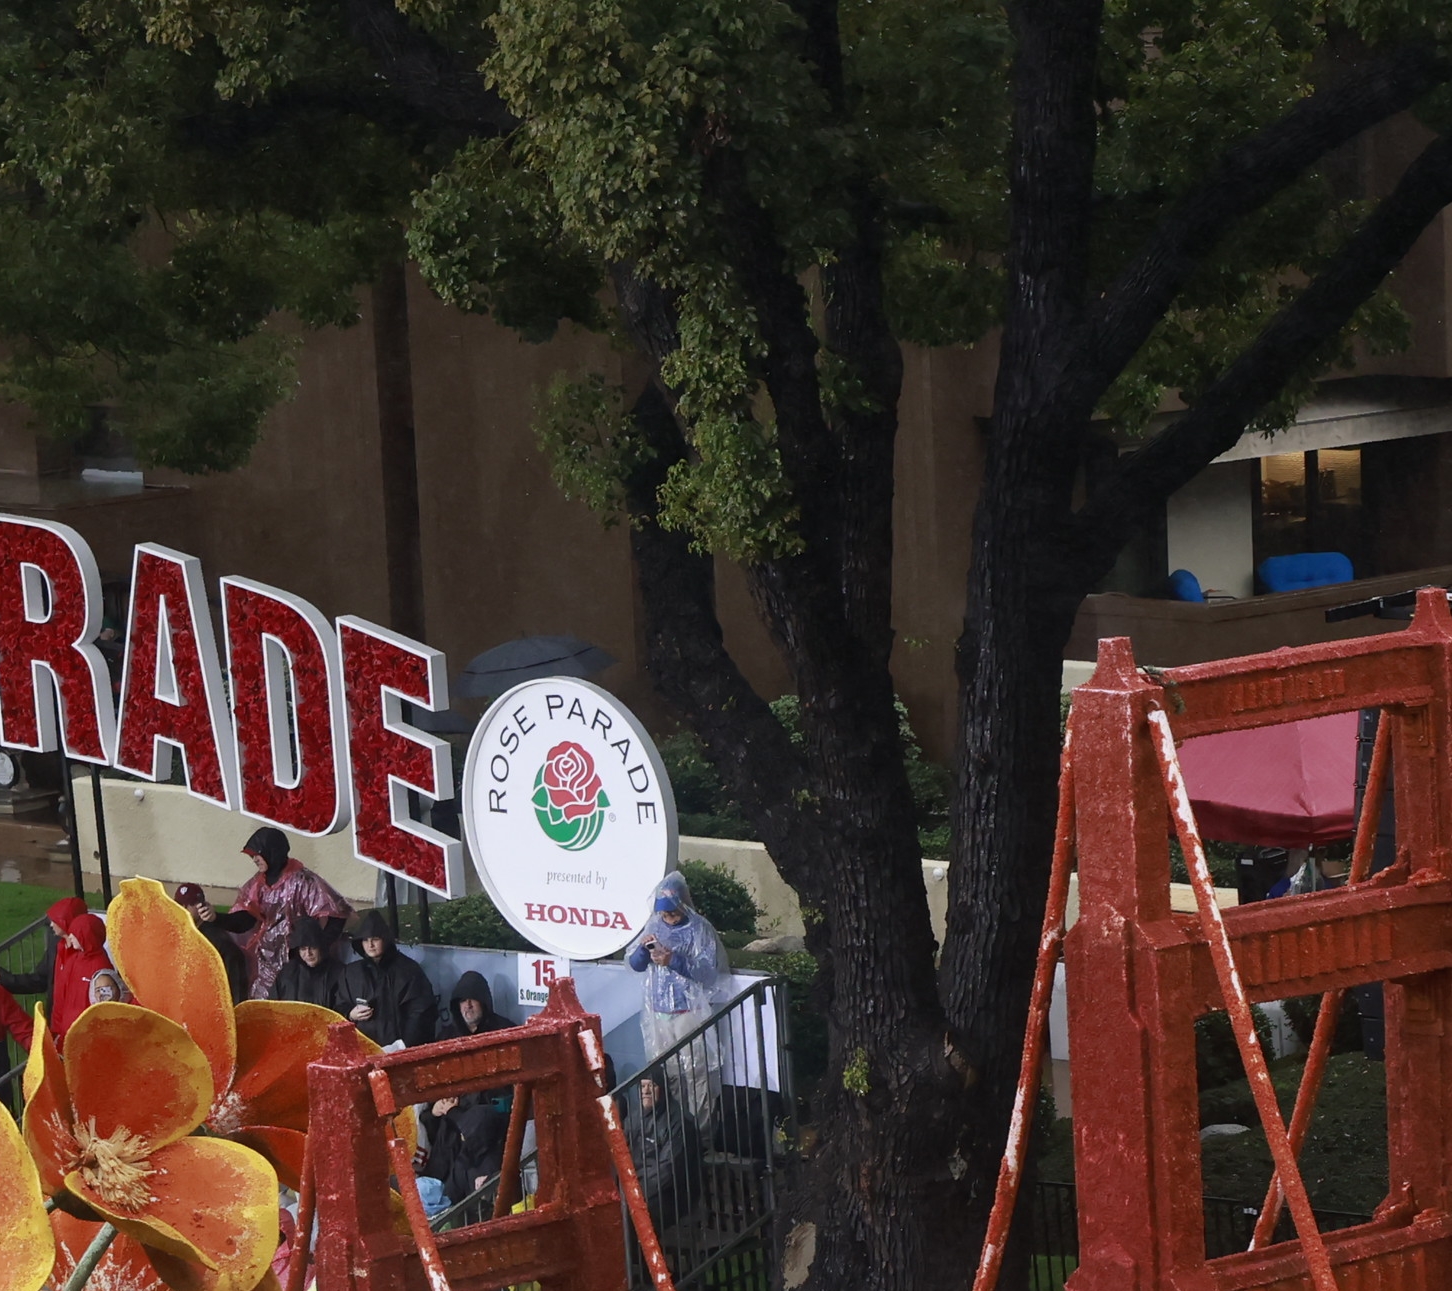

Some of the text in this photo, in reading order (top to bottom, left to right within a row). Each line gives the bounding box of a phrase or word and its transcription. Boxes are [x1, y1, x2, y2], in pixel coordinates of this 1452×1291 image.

[489, 694, 657, 825] ROSE PARADE
[547, 870, 607, 889] presented by
[524, 903, 632, 931] HONDA
[531, 959, 556, 988] 15
[520, 988, 548, 1003] S. Orange
